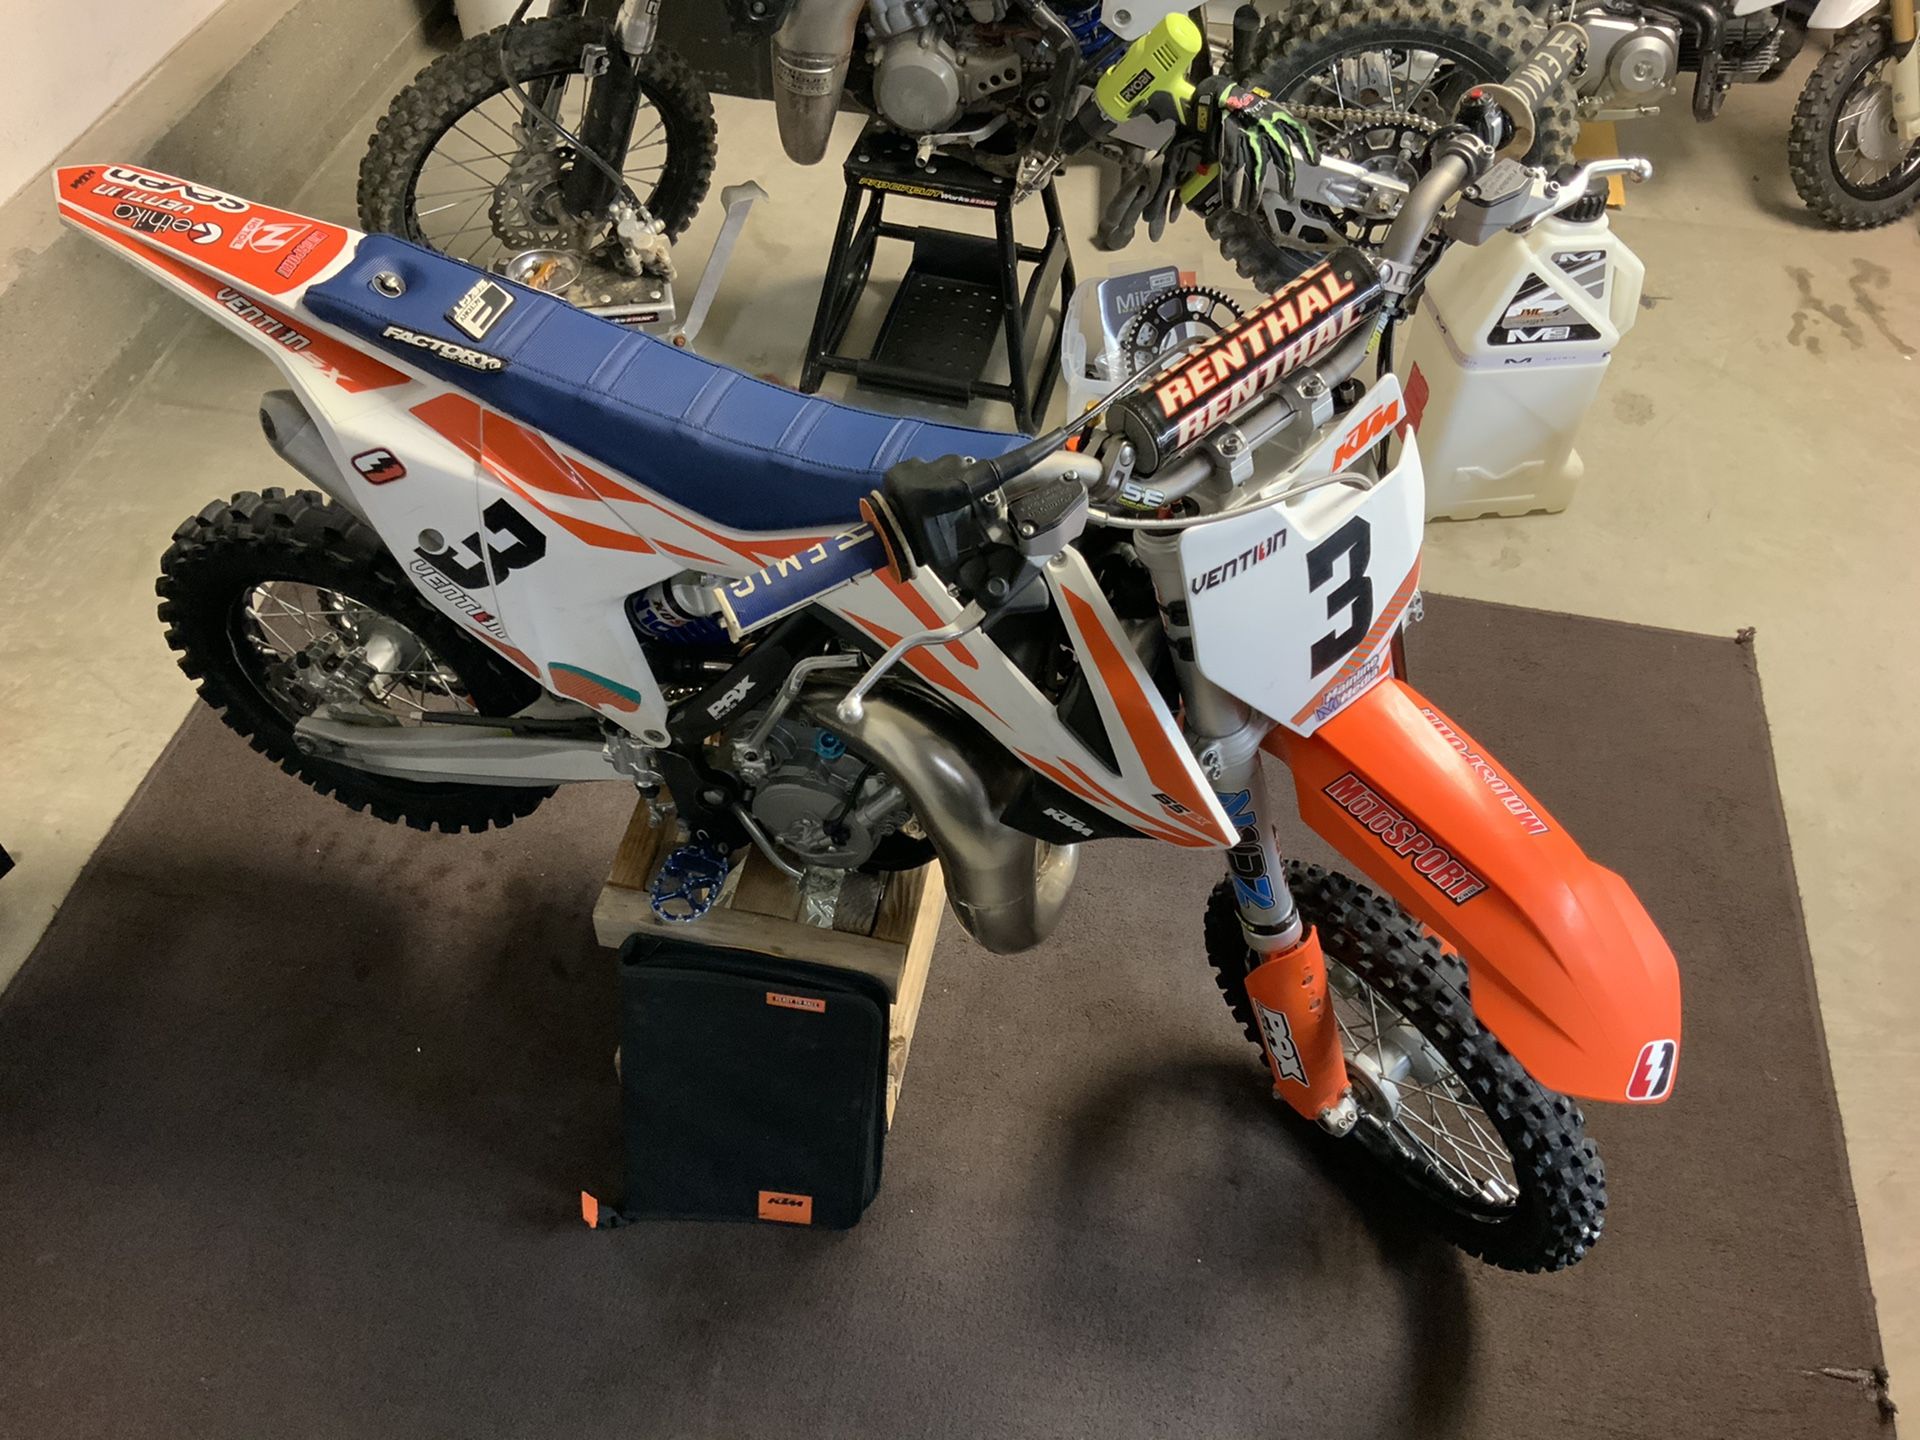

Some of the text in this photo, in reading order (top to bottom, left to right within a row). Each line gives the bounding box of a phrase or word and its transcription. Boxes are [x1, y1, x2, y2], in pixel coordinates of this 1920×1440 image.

[1121, 72, 1154, 102] RYOBI
[113, 203, 193, 232] ethika
[383, 326, 490, 369] FACTORY
[1155, 271, 1355, 419] RENTHAL
[1176, 301, 1361, 451] RENTHAL
[1331, 398, 1399, 473] KTM
[413, 498, 547, 590] 3
[1305, 515, 1374, 680] 3
[706, 675, 757, 717] PAX
[1042, 807, 1094, 837] KTM
[1152, 793, 1190, 814] 65
[767, 1197, 804, 1208] KTM
